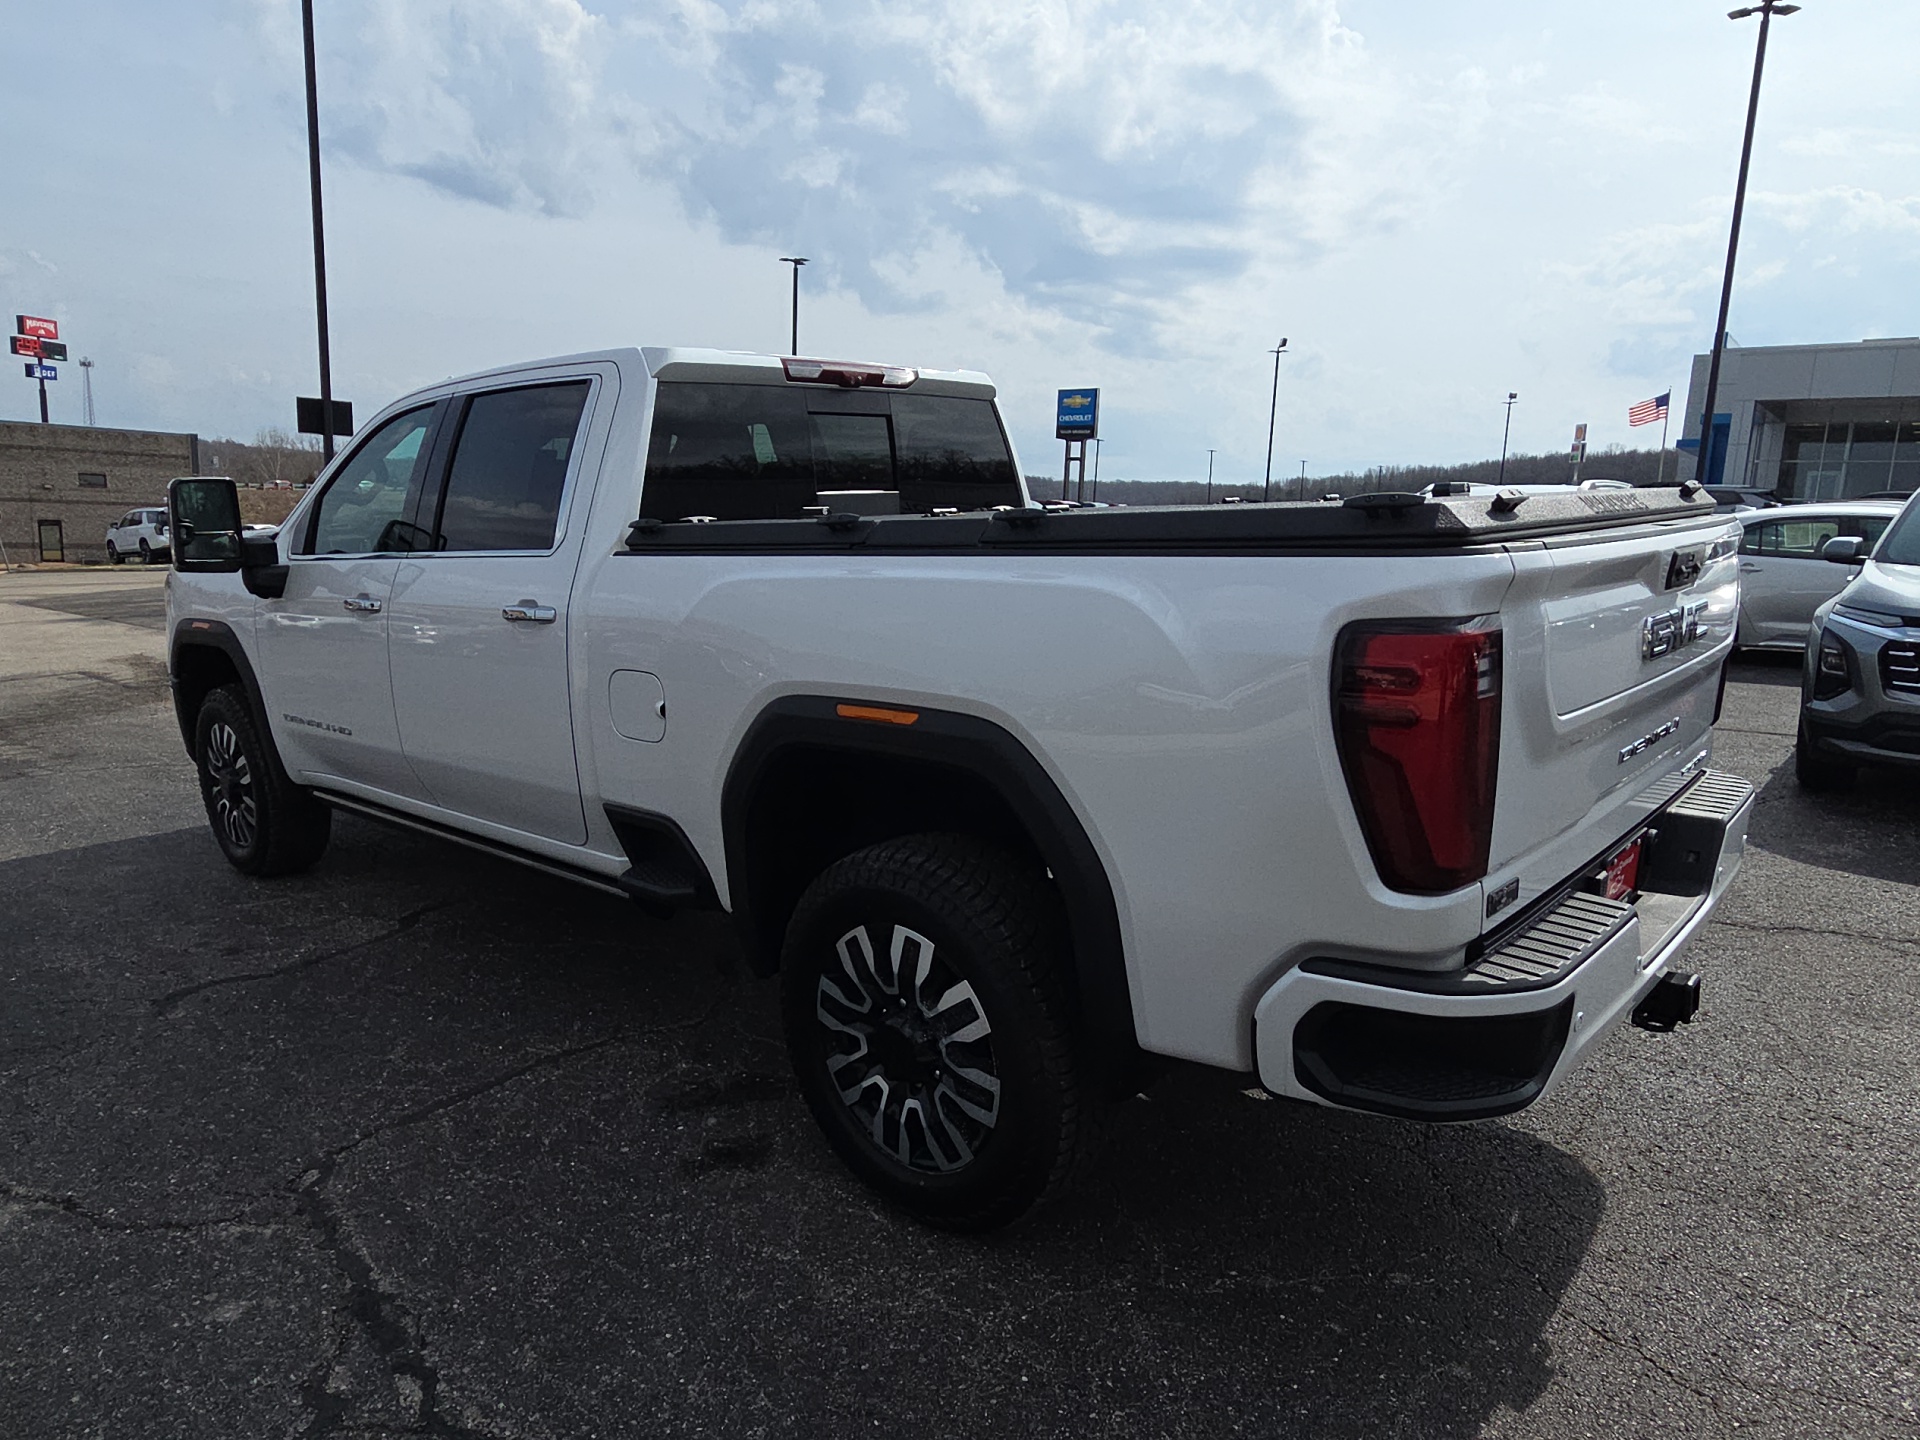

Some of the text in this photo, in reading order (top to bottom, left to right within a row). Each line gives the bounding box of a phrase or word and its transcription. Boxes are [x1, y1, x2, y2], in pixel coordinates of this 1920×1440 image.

[1059, 414, 1092, 422] CHEVROLET
[1641, 598, 1709, 662] GMC
[1618, 716, 1680, 766] DENALI
